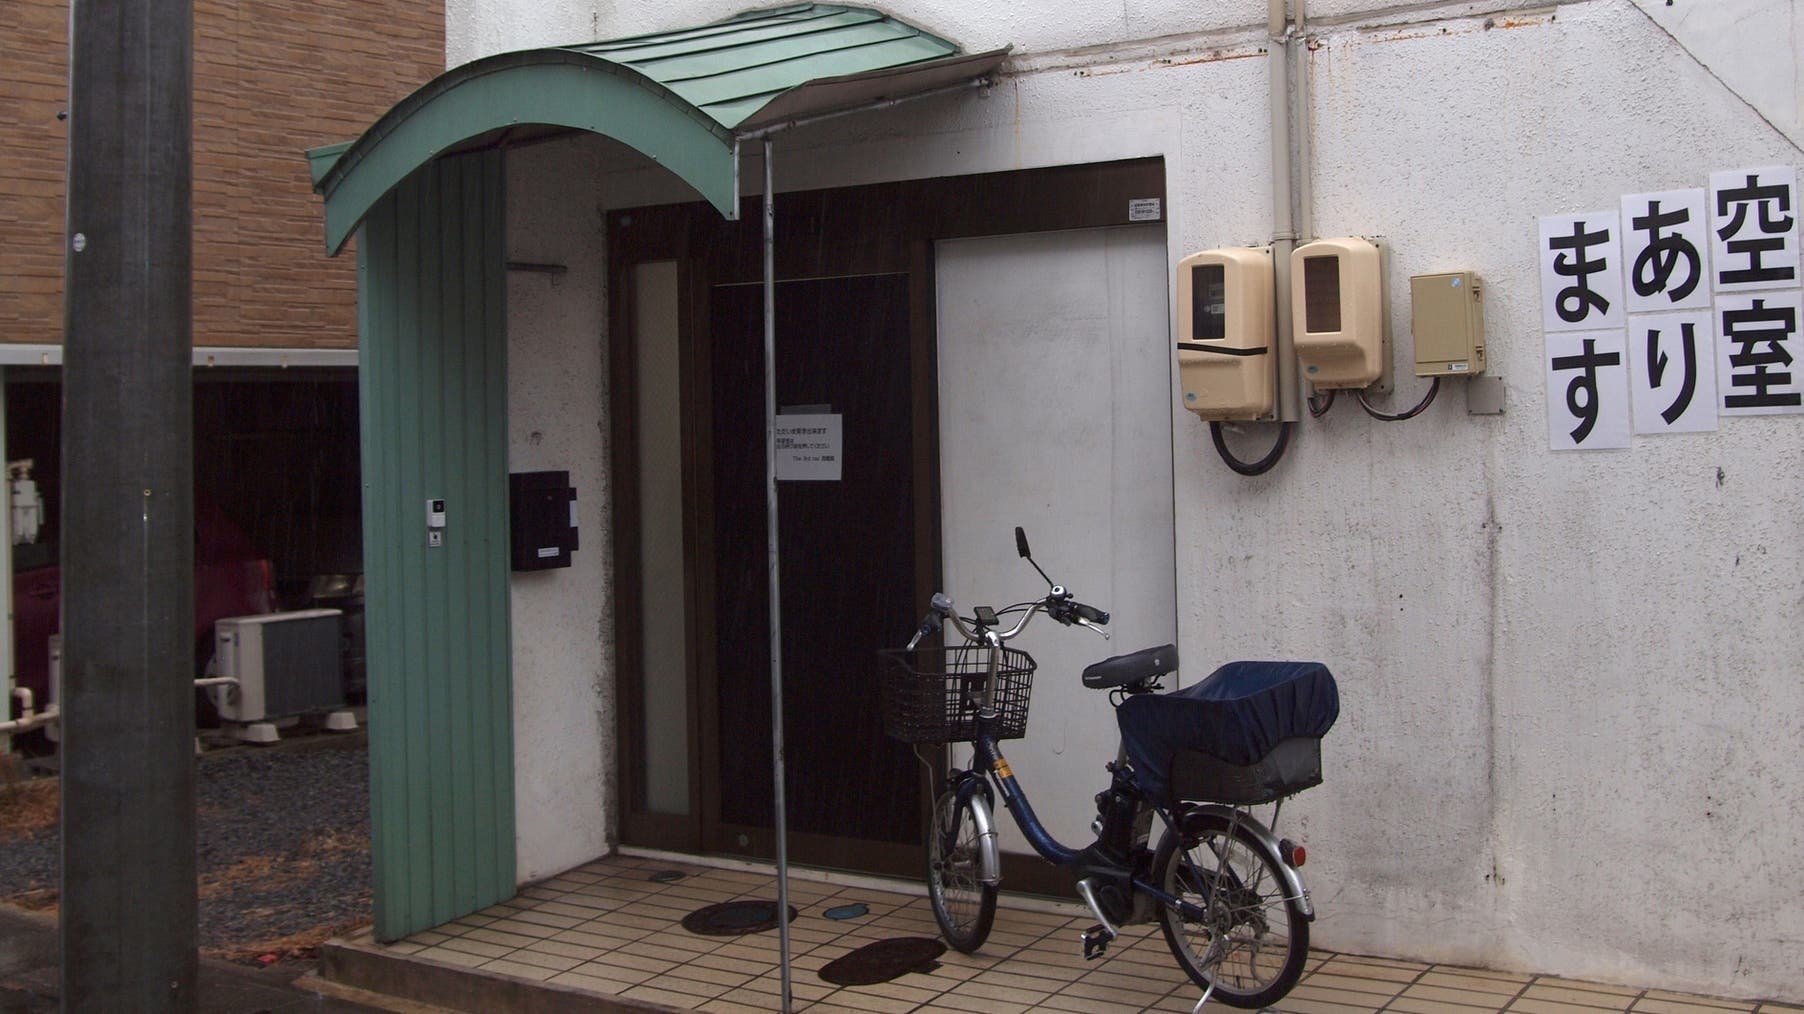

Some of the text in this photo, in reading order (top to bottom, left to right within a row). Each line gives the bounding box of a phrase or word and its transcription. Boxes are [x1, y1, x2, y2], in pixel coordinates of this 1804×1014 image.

[1549, 221, 1620, 444] ます
[1632, 200, 1701, 425] あり
[1717, 174, 1802, 408] 空室
